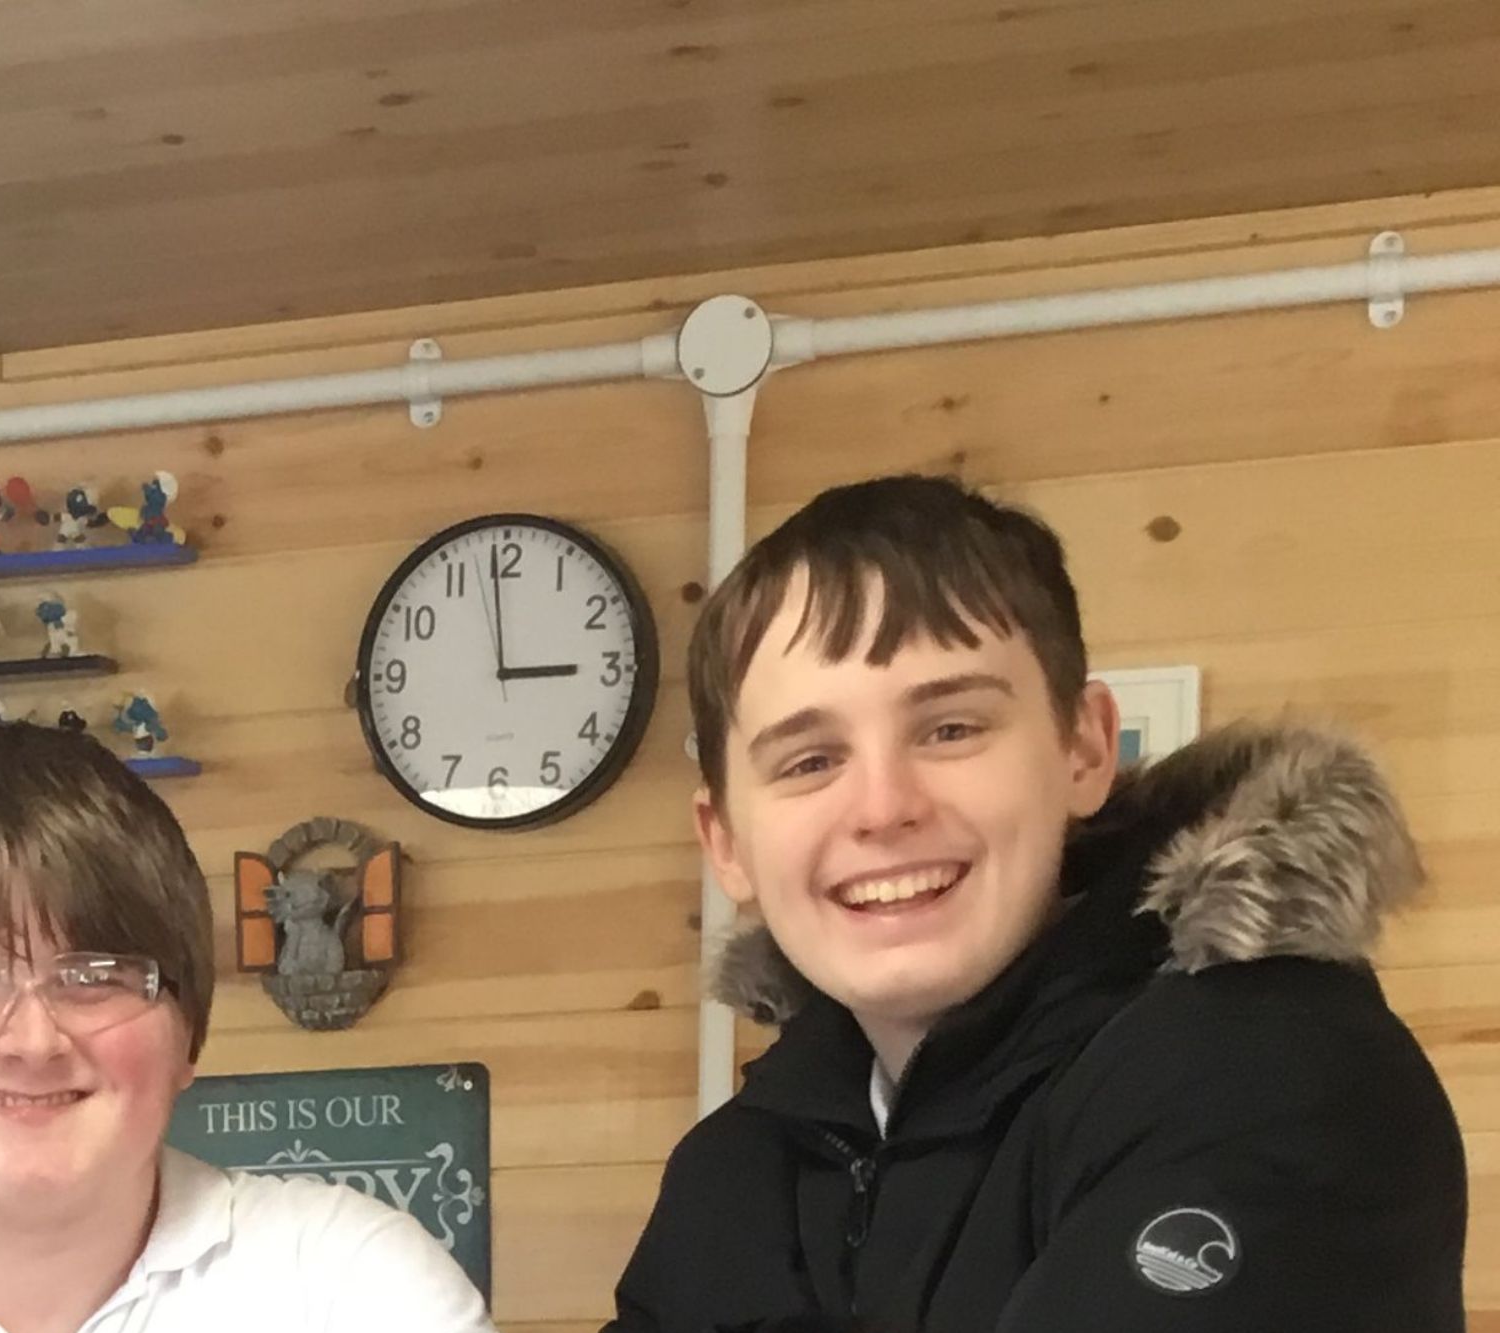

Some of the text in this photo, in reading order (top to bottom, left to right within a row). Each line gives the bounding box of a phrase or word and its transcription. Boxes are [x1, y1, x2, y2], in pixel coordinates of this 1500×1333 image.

[489, 542, 523, 579] 12
[556, 555, 565, 592] 1
[445, 562, 466, 598] 11
[404, 604, 436, 641] 10
[584, 594, 608, 630] 2
[385, 659, 408, 694] 9
[600, 651, 622, 687] 3
[400, 715, 422, 750] 8
[577, 711, 601, 746] 4
[441, 754, 463, 789] 7
[487, 766, 509, 800] 6
[539, 751, 562, 786] 5
[200, 1095, 406, 1134] THIS IS OUR
